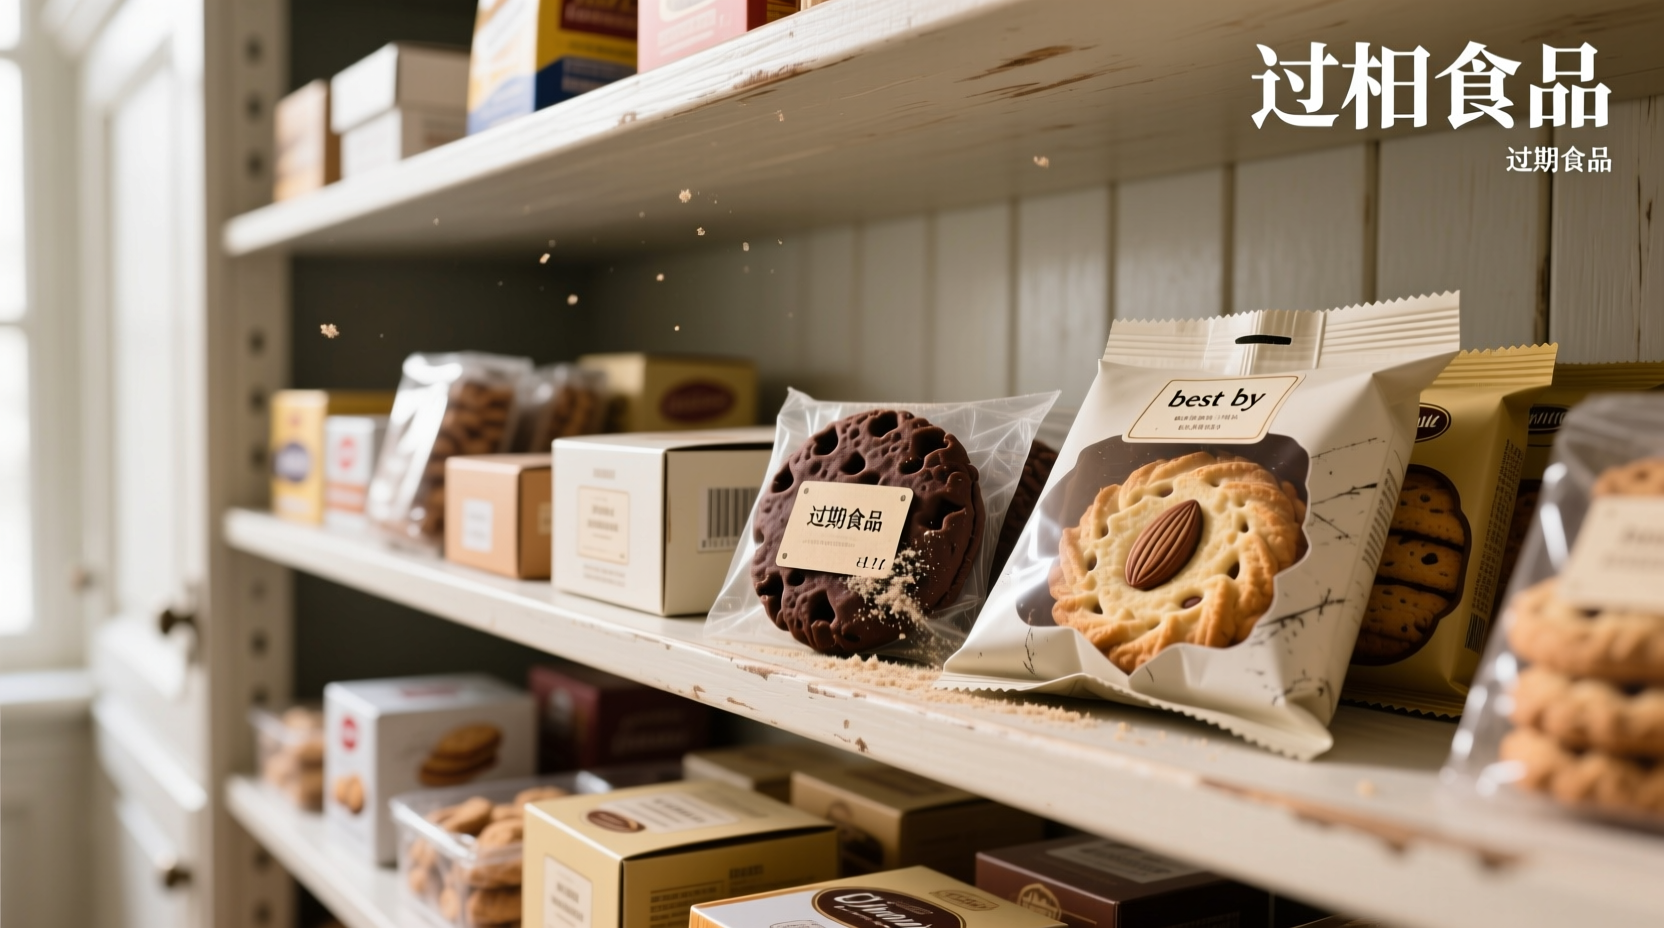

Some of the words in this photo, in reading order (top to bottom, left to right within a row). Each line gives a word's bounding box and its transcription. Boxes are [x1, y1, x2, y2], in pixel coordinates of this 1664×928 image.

[1167, 389, 1225, 408] best
[1230, 388, 1266, 412] by
[806, 505, 883, 533] 过期食品
